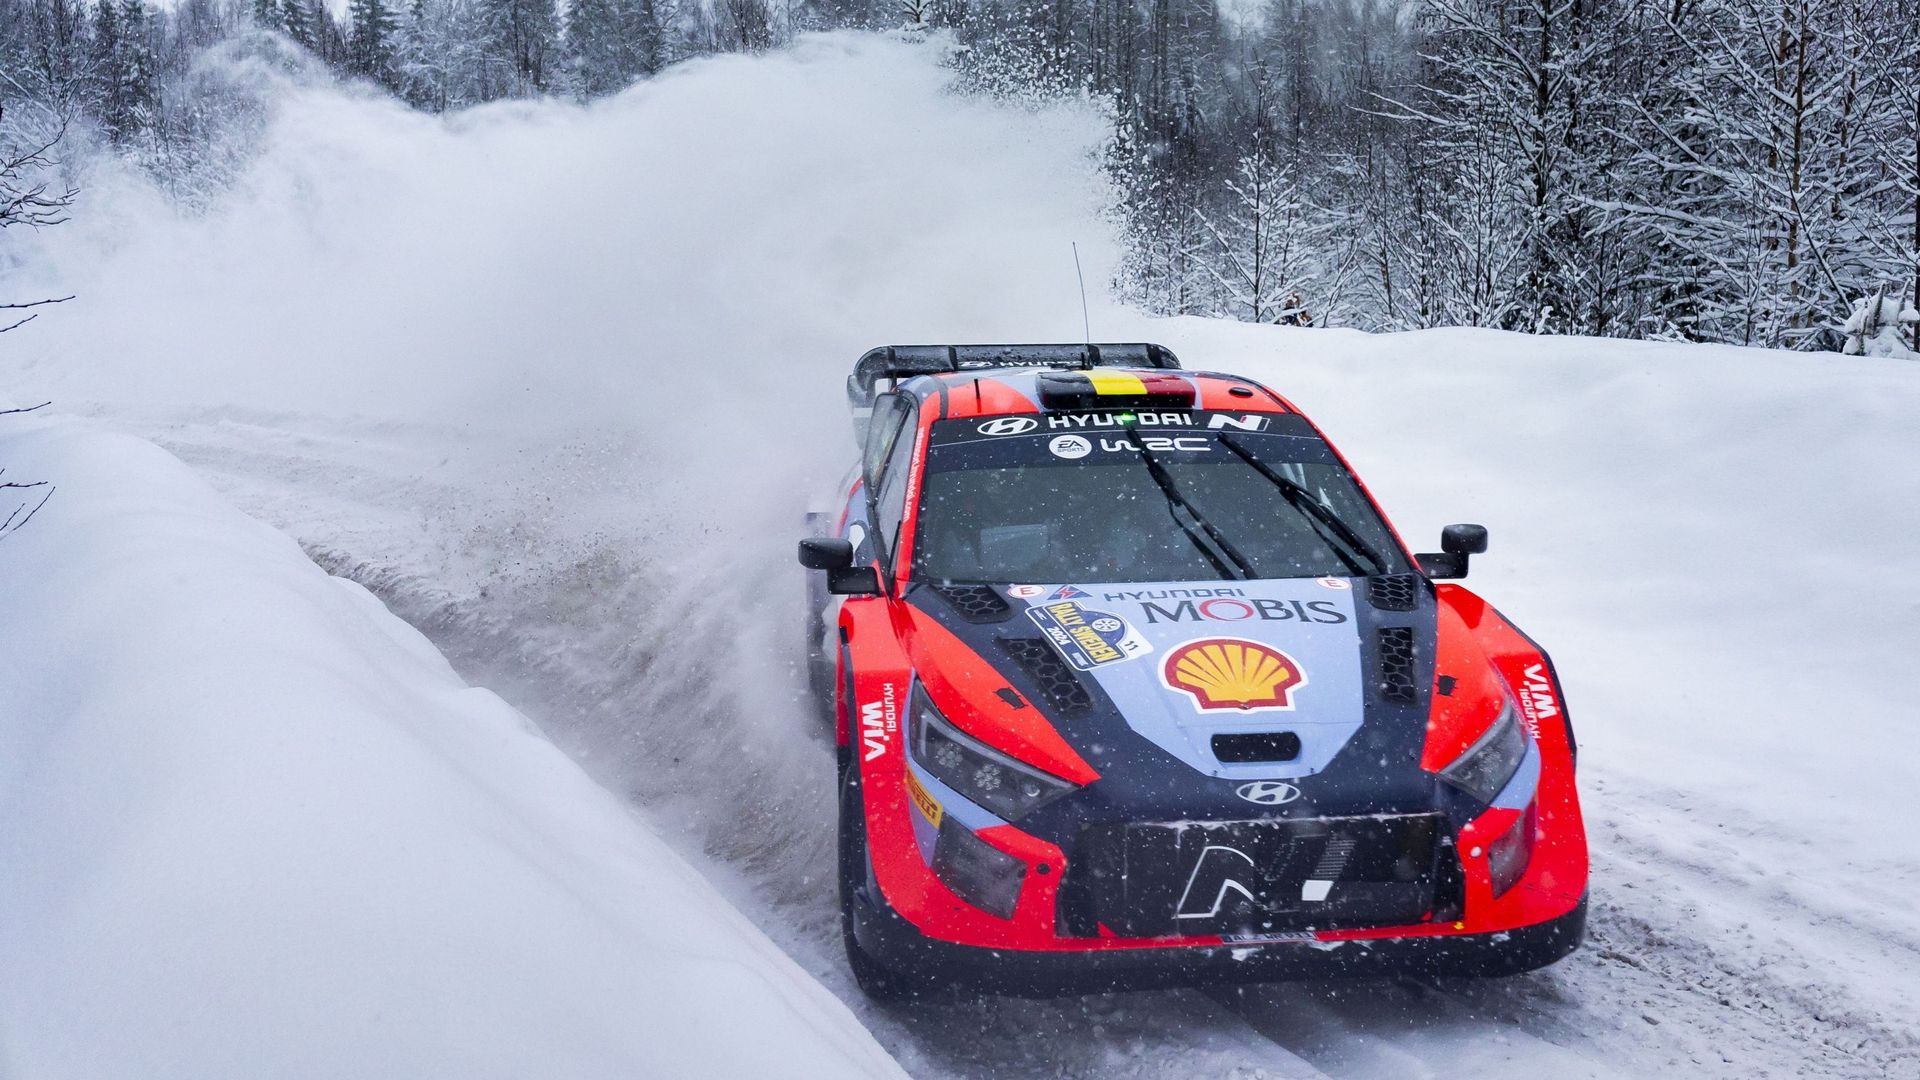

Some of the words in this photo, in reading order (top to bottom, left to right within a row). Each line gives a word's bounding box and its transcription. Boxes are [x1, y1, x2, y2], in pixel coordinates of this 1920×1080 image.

[1057, 440, 1084, 448] EA
[1100, 437, 1211, 452] WRC
[1020, 586, 1035, 595] E
[1324, 579, 1342, 587] E
[1104, 588, 1245, 601] HYUNDAI
[1139, 598, 1347, 624] MOBIS
[1045, 627, 1072, 645] 2024
[1047, 602, 1085, 626] RALLY
[1069, 625, 1121, 662] SWEDEN
[1124, 640, 1139, 651] 11
[883, 683, 897, 732] HYUNDAI
[1518, 688, 1542, 739] HYUNDAI
